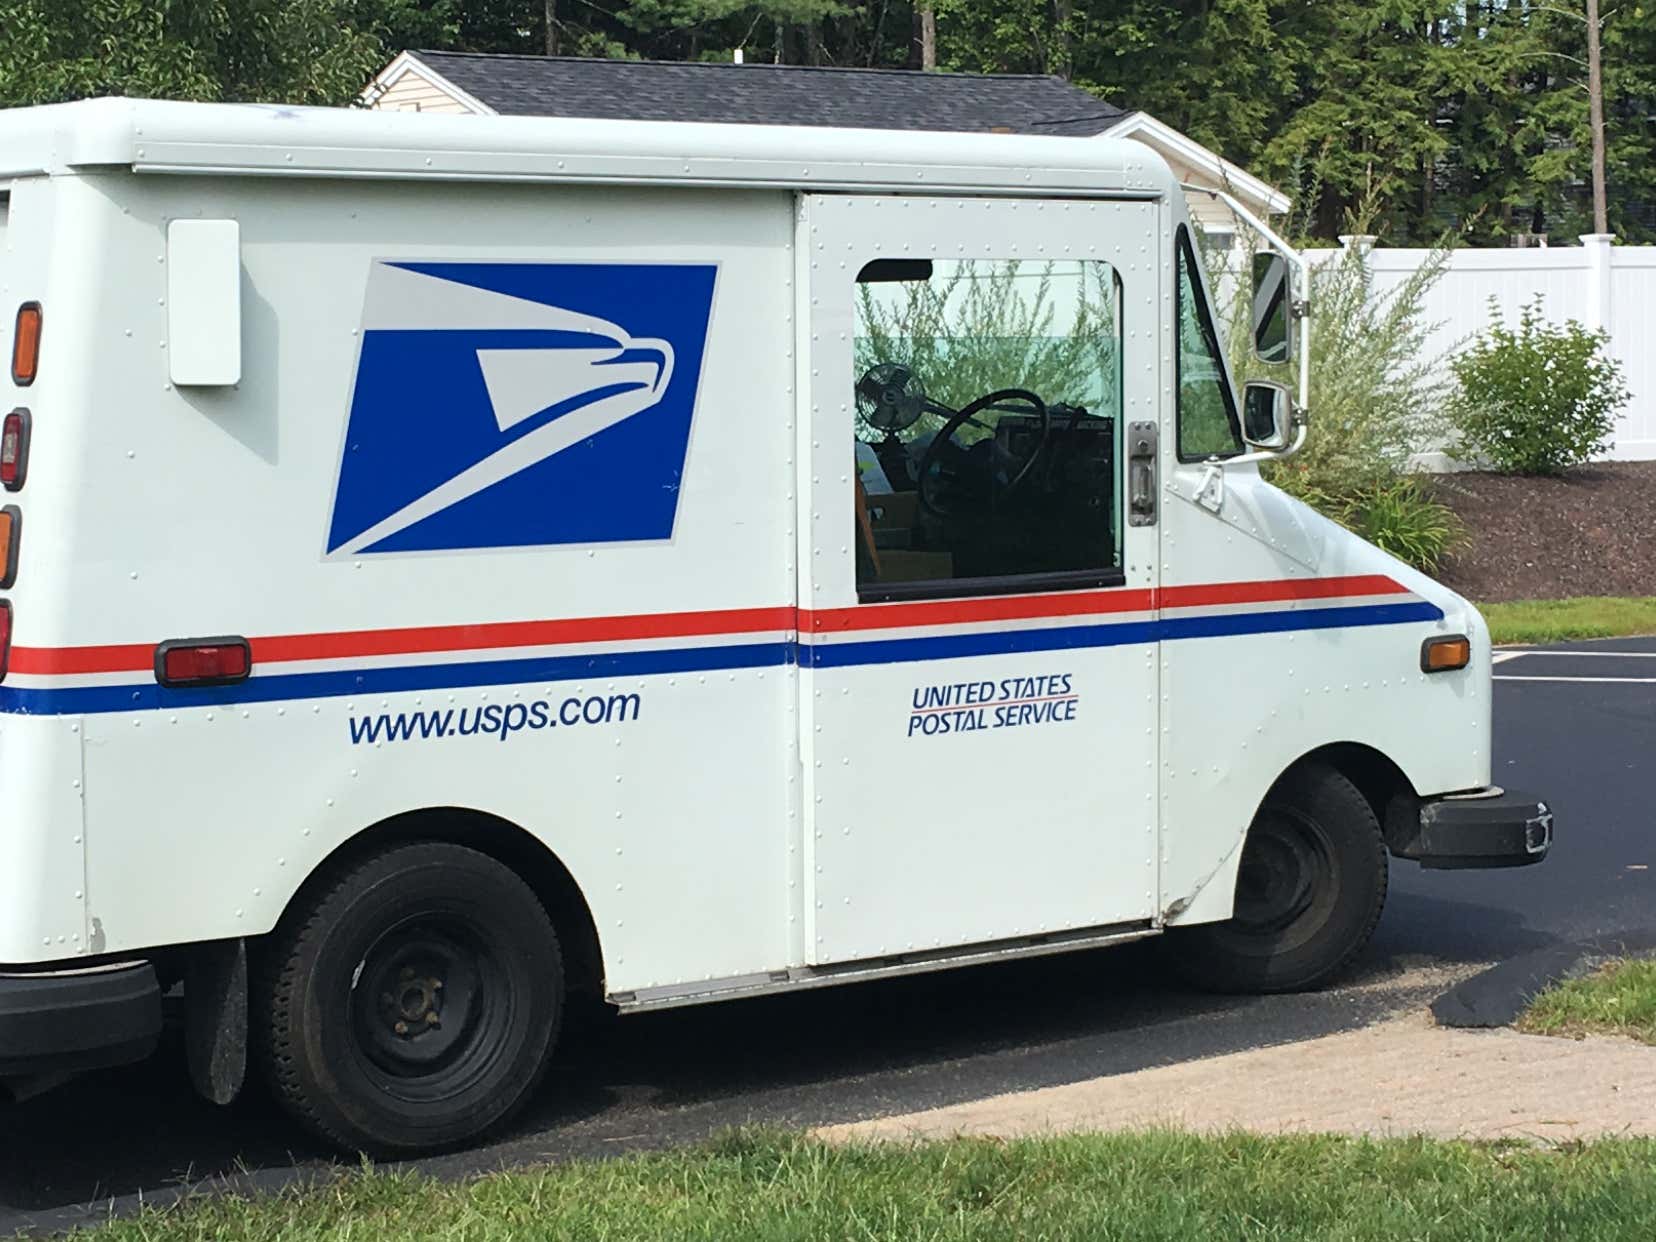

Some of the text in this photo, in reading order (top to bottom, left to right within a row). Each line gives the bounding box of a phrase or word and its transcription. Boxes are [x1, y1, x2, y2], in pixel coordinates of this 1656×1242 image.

[912, 673, 1072, 709] UNITED STATES
[349, 693, 641, 744] www.usps.com
[908, 699, 1079, 737] POSTAL SERVICE
